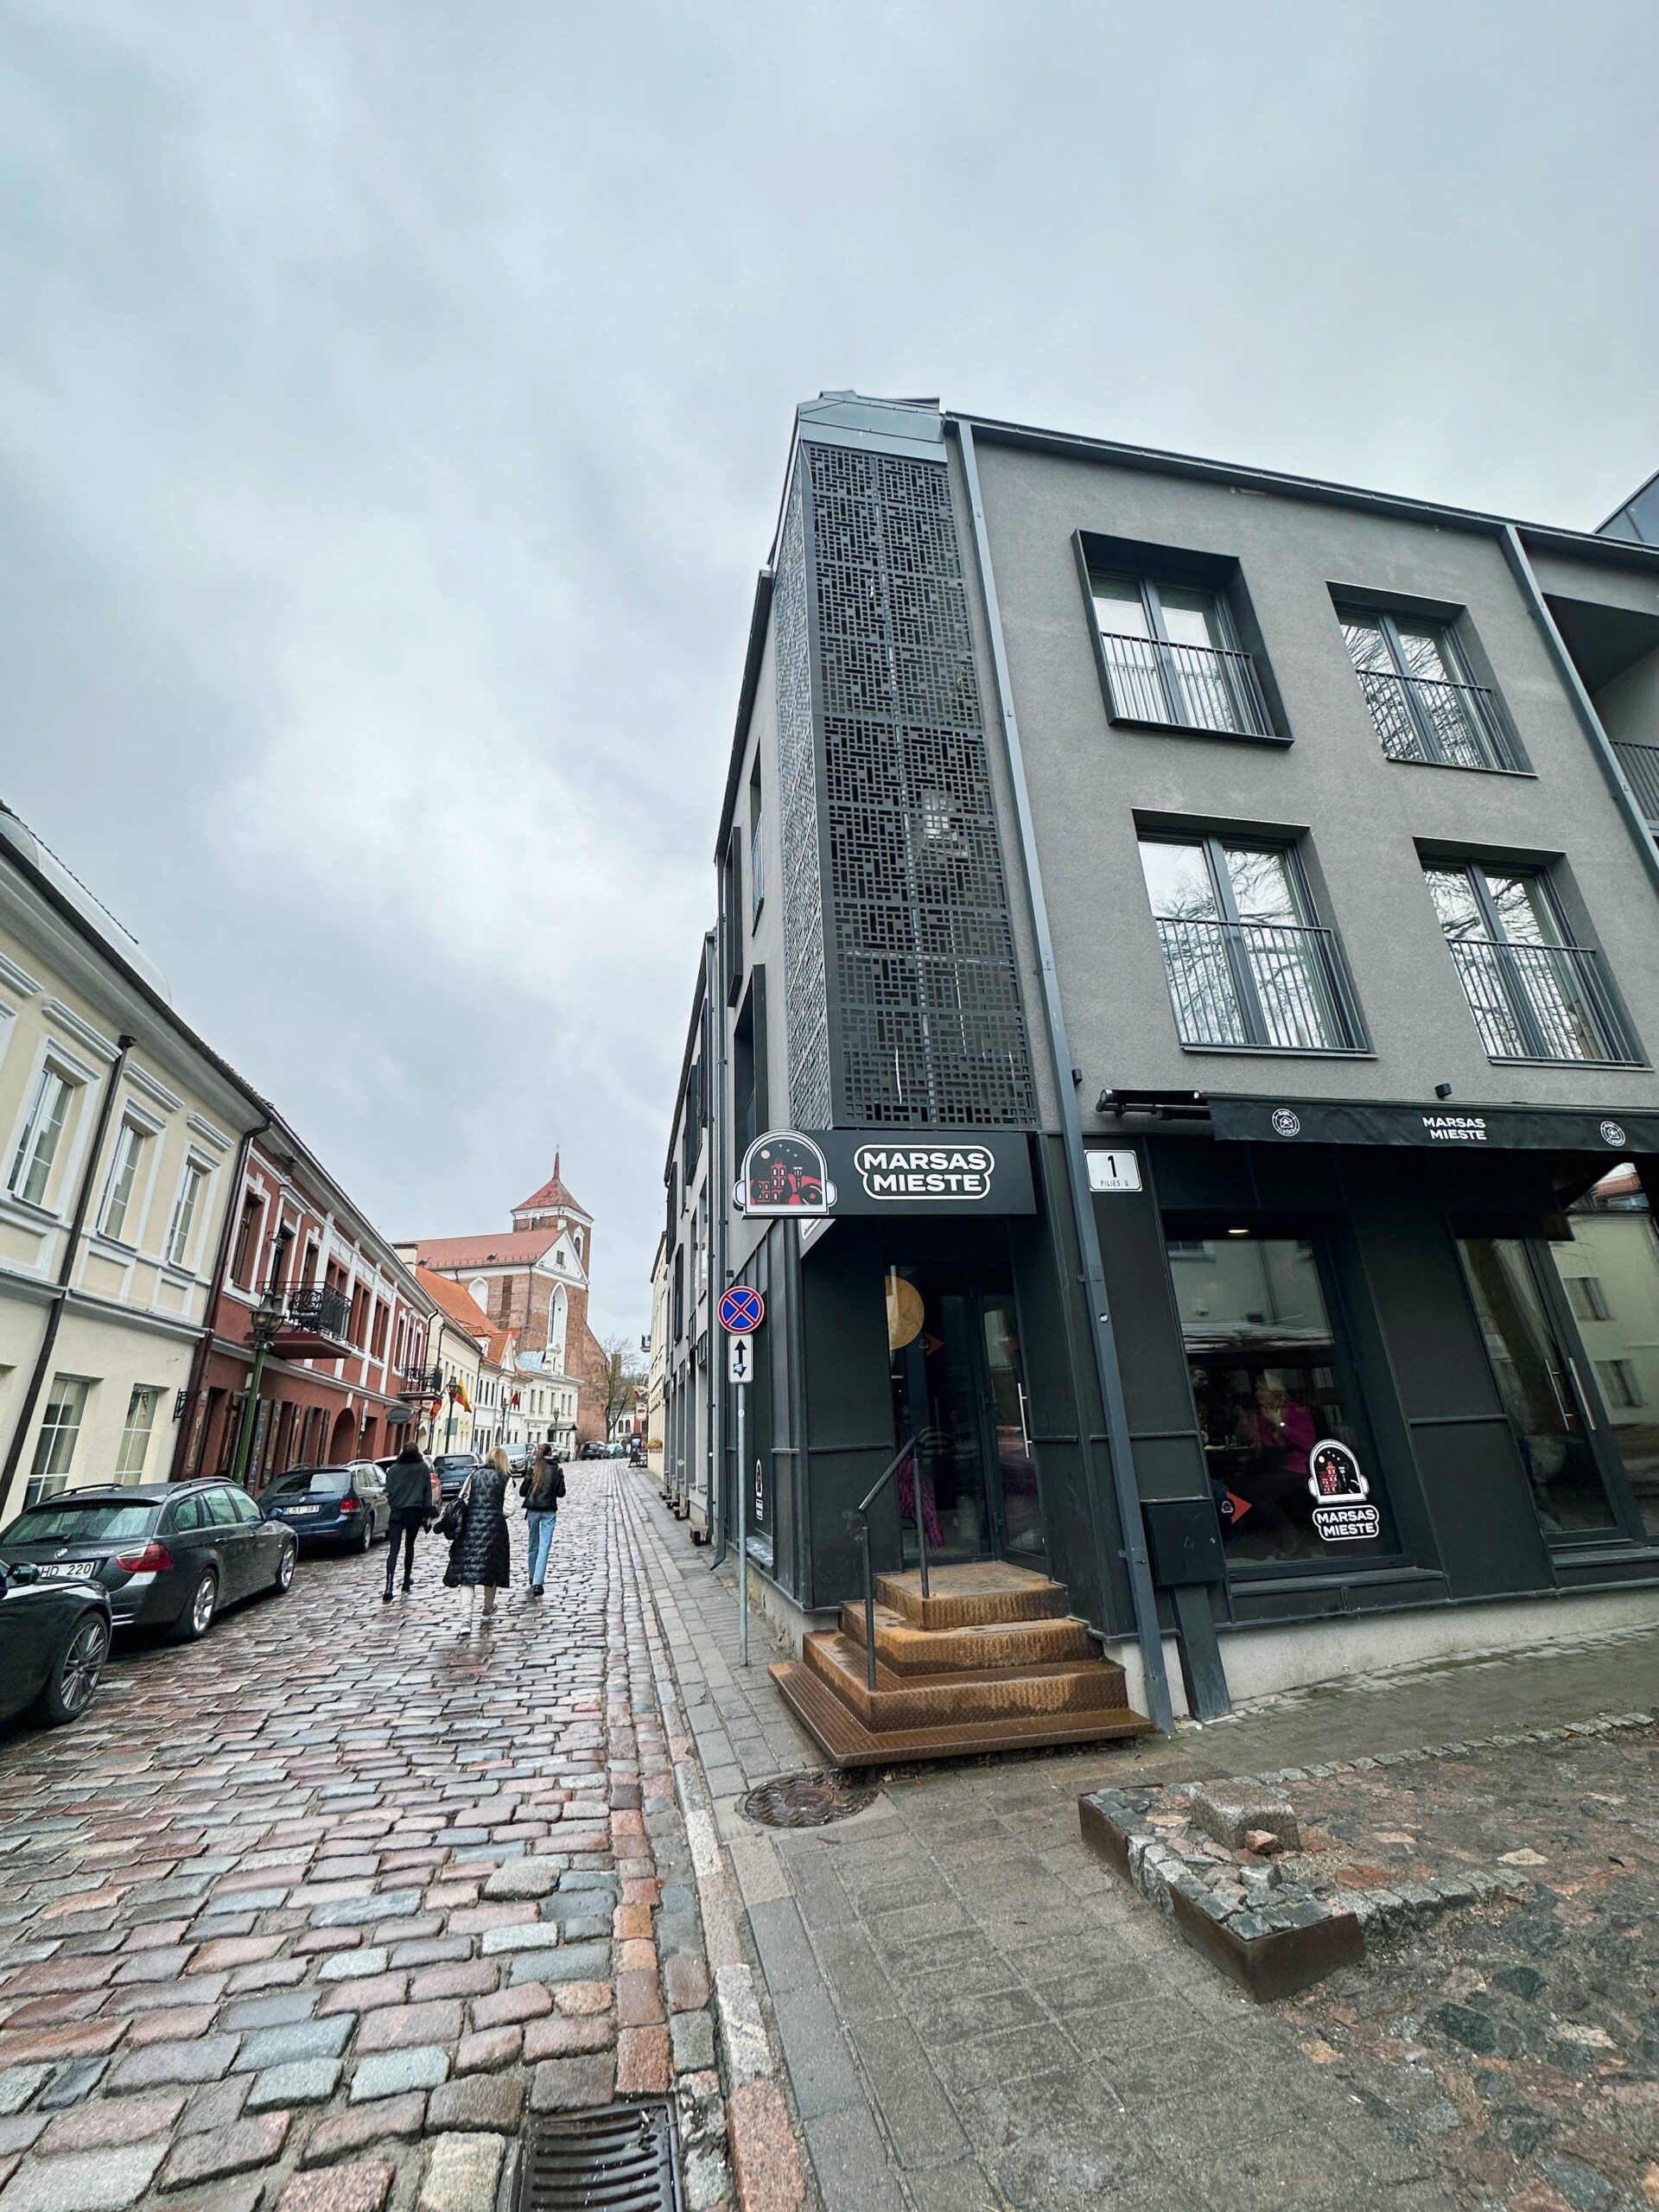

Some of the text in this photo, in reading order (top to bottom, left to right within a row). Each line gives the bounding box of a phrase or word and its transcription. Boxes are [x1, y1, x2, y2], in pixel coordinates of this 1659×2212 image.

[1422, 1117, 1486, 1128] MARSAS
[1430, 1129, 1487, 1140] MIESTE
[864, 1153, 987, 1170] MARSAS
[1108, 1155, 1117, 1178] 1
[873, 1173, 982, 1192] MIESTE
[1317, 1510, 1376, 1523] MARSAS
[1323, 1522, 1376, 1536] MIESTE
[67, 1563, 92, 1576] 220
